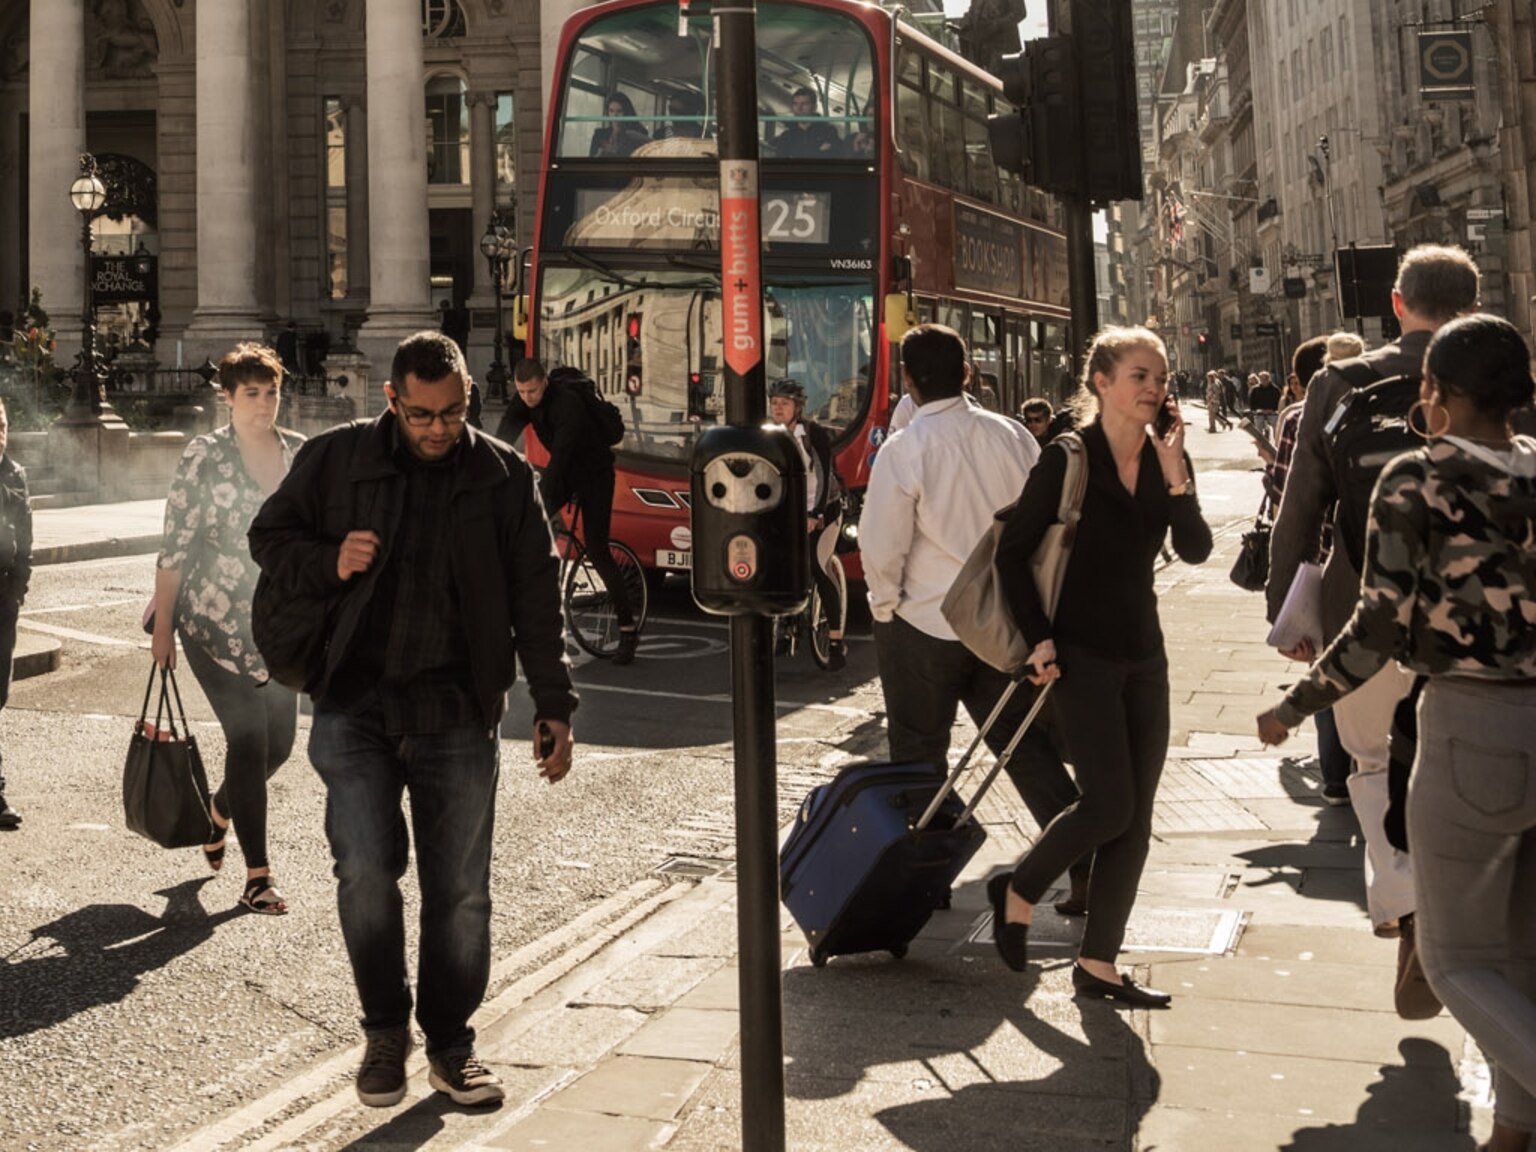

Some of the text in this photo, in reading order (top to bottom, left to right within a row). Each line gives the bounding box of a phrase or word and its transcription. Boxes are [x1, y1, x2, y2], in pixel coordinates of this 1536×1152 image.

[595, 206, 661, 226] Oxford
[767, 198, 817, 238] 25
[728, 210, 749, 275] butts
[104, 261, 126, 272] THE
[830, 259, 873, 269] VN36163
[96, 271, 133, 281] ROYAL
[91, 281, 145, 292] XCHANGE
[733, 297, 754, 350] gum
